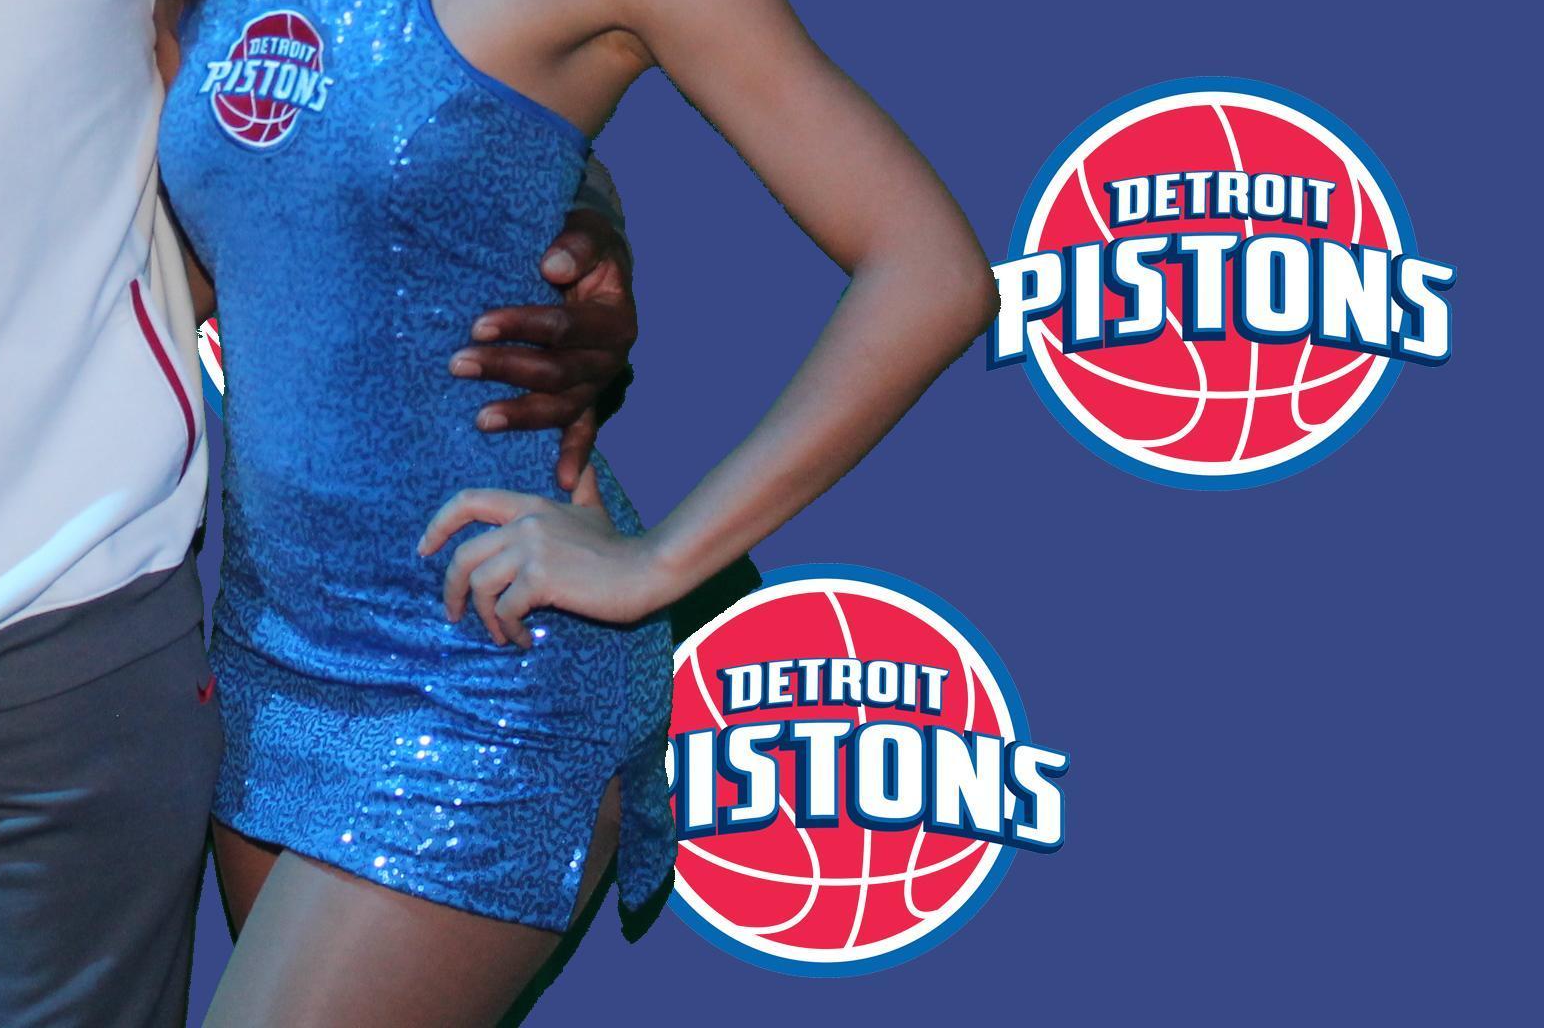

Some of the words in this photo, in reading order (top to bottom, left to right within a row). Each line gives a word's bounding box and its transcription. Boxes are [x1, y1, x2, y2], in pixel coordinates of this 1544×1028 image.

[249, 36, 317, 63] DETROIT
[199, 59, 335, 112] PISTONS
[1104, 170, 1336, 228] DETROIT
[987, 233, 1457, 371] PISTONS
[717, 657, 949, 715] DETROIT
[665, 720, 1070, 855] ISTONS
